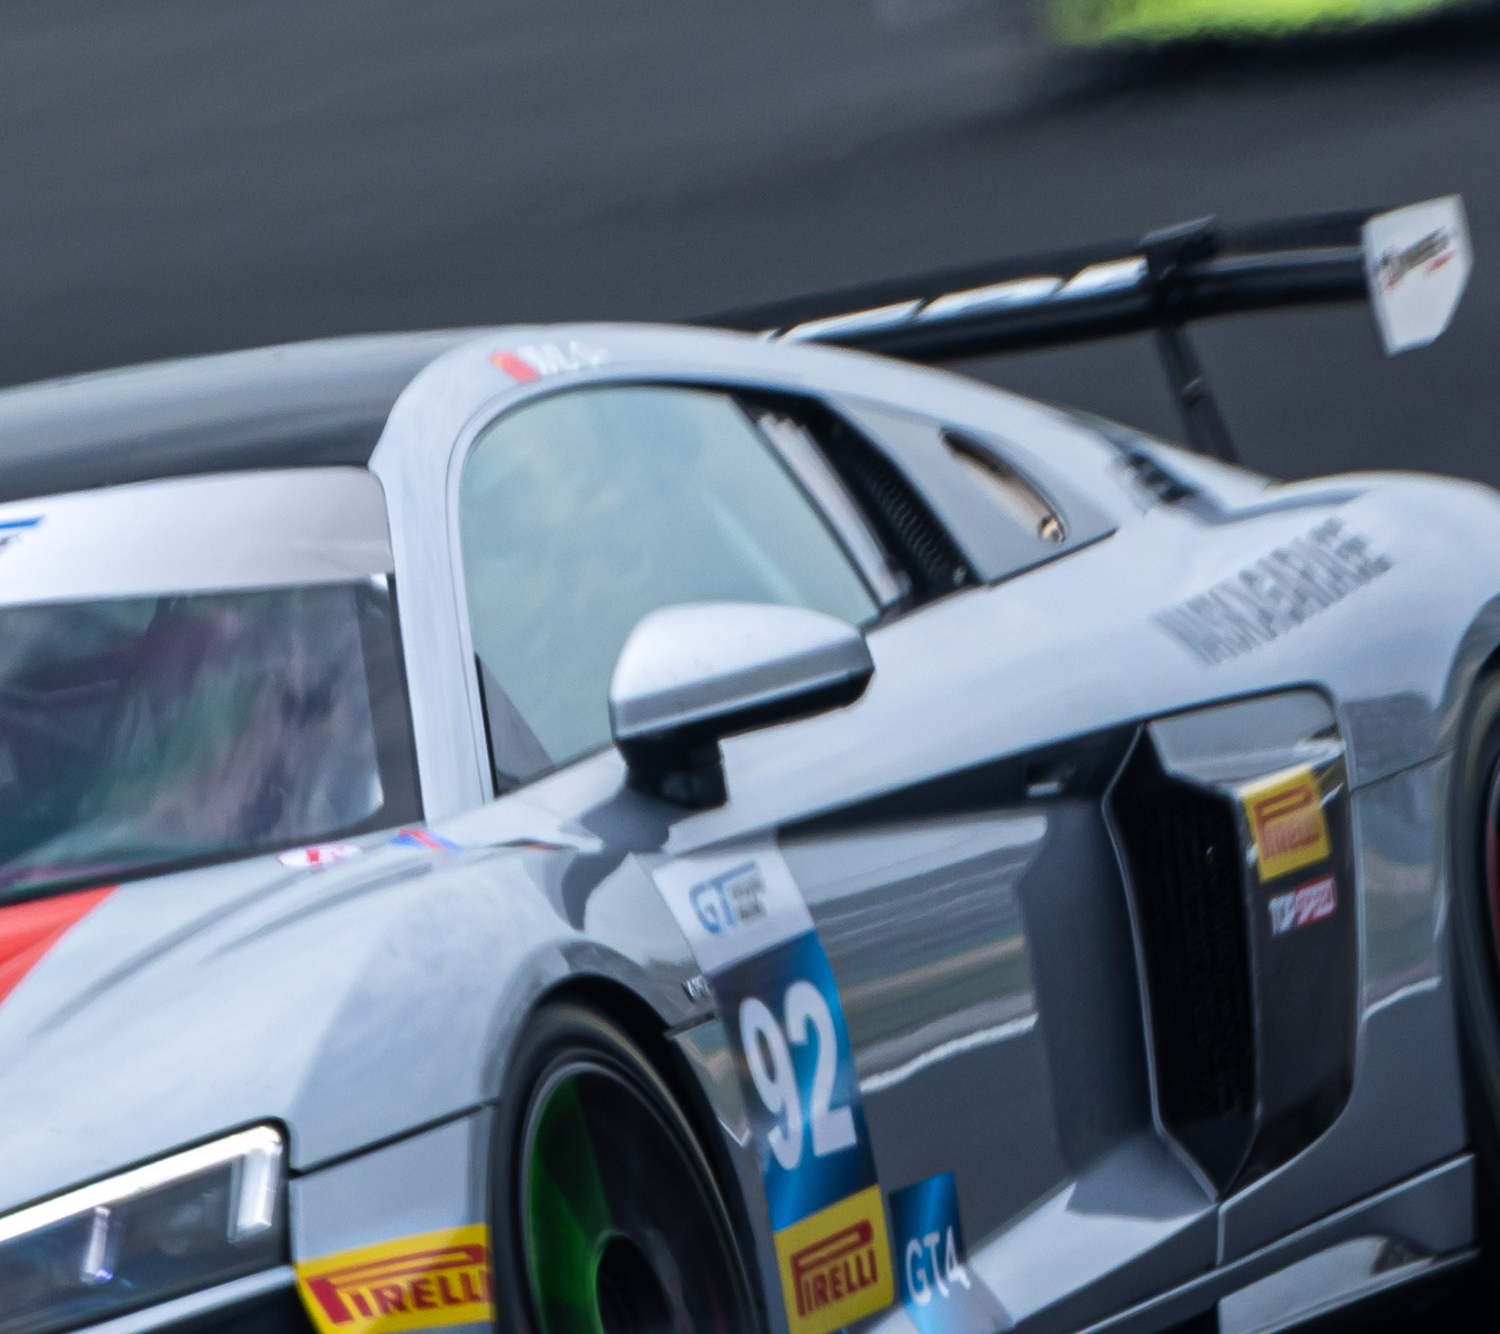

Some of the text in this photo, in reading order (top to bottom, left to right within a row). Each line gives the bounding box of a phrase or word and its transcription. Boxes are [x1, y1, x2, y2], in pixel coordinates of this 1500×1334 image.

[738, 979, 858, 1171] 92
[306, 1243, 495, 1326] PIRELLI
[790, 1218, 879, 1318] PIRELLI
[904, 1225, 972, 1305] GT4
